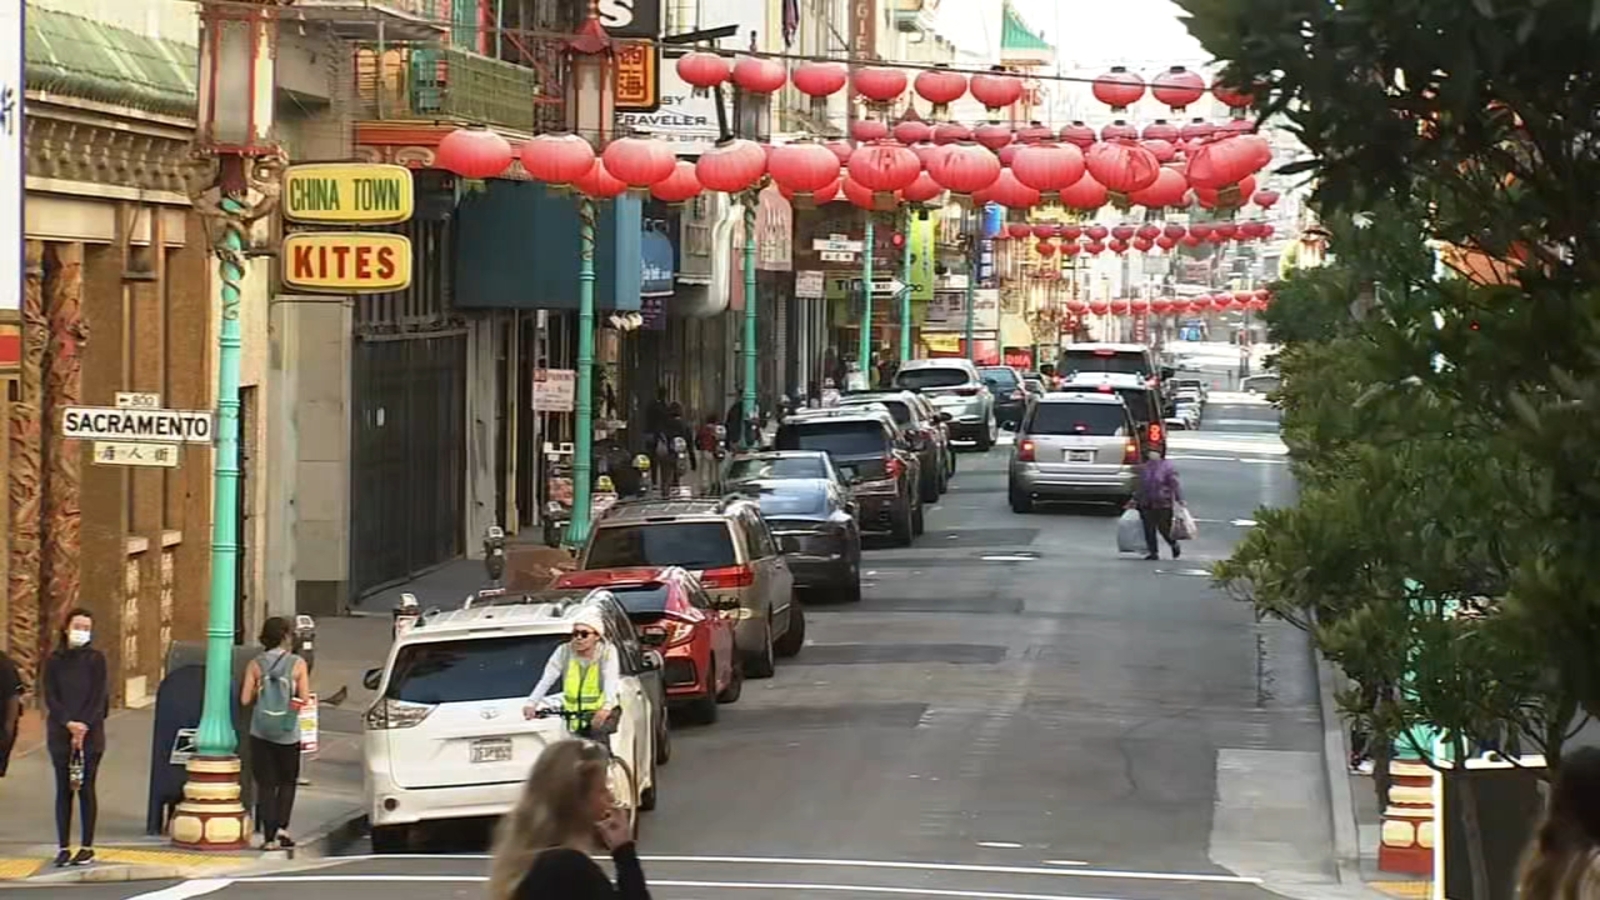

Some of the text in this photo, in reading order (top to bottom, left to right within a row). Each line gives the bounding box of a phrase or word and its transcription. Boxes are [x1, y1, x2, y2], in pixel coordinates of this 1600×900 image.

[290, 178, 400, 211] CHINA TOWN
[294, 245, 396, 279] KITES
[65, 412, 208, 437] SACRAMENTO
